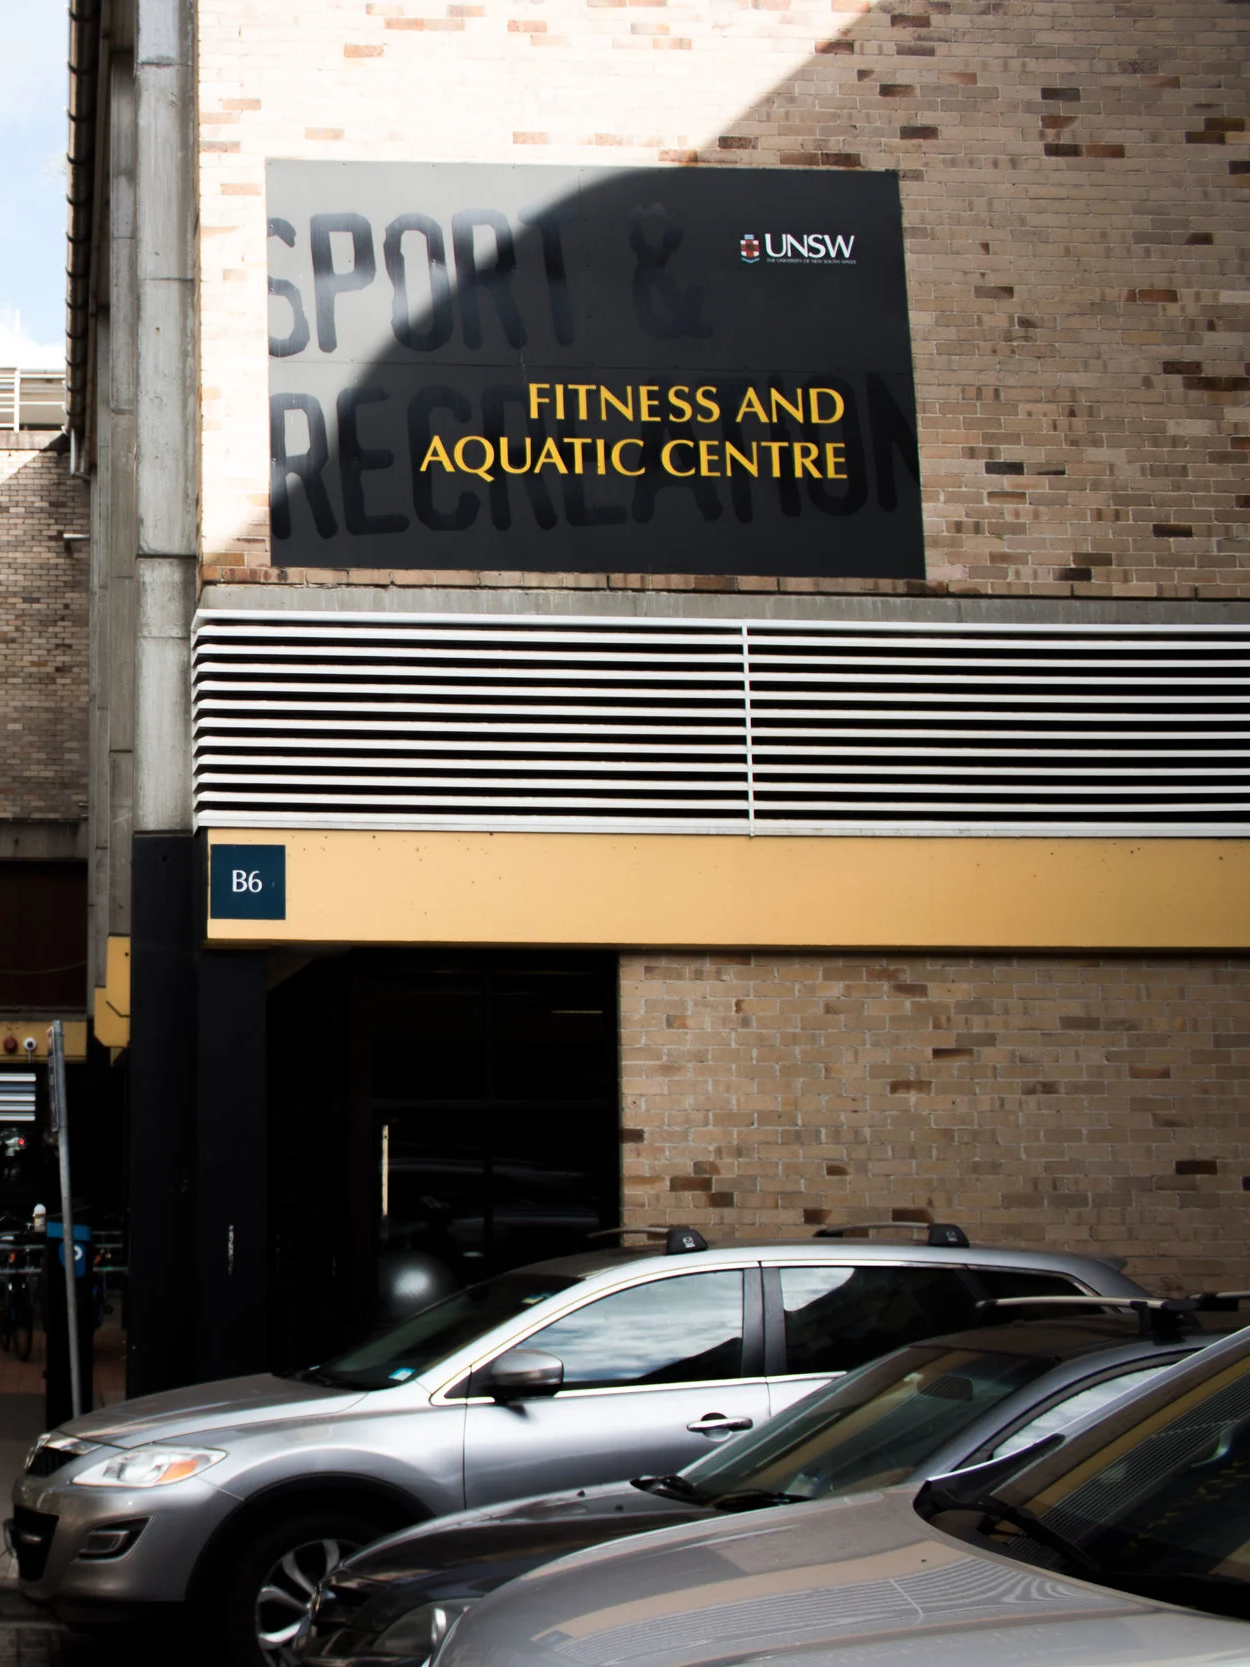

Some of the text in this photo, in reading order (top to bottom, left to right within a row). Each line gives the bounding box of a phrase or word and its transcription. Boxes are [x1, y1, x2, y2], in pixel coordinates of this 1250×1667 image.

[765, 233, 855, 259] UNSW
[267, 208, 577, 358] SPORT
[528, 383, 845, 424] FITNESS AND
[420, 435, 848, 483] AQUATIC CENTRE
[232, 869, 263, 893] B6
